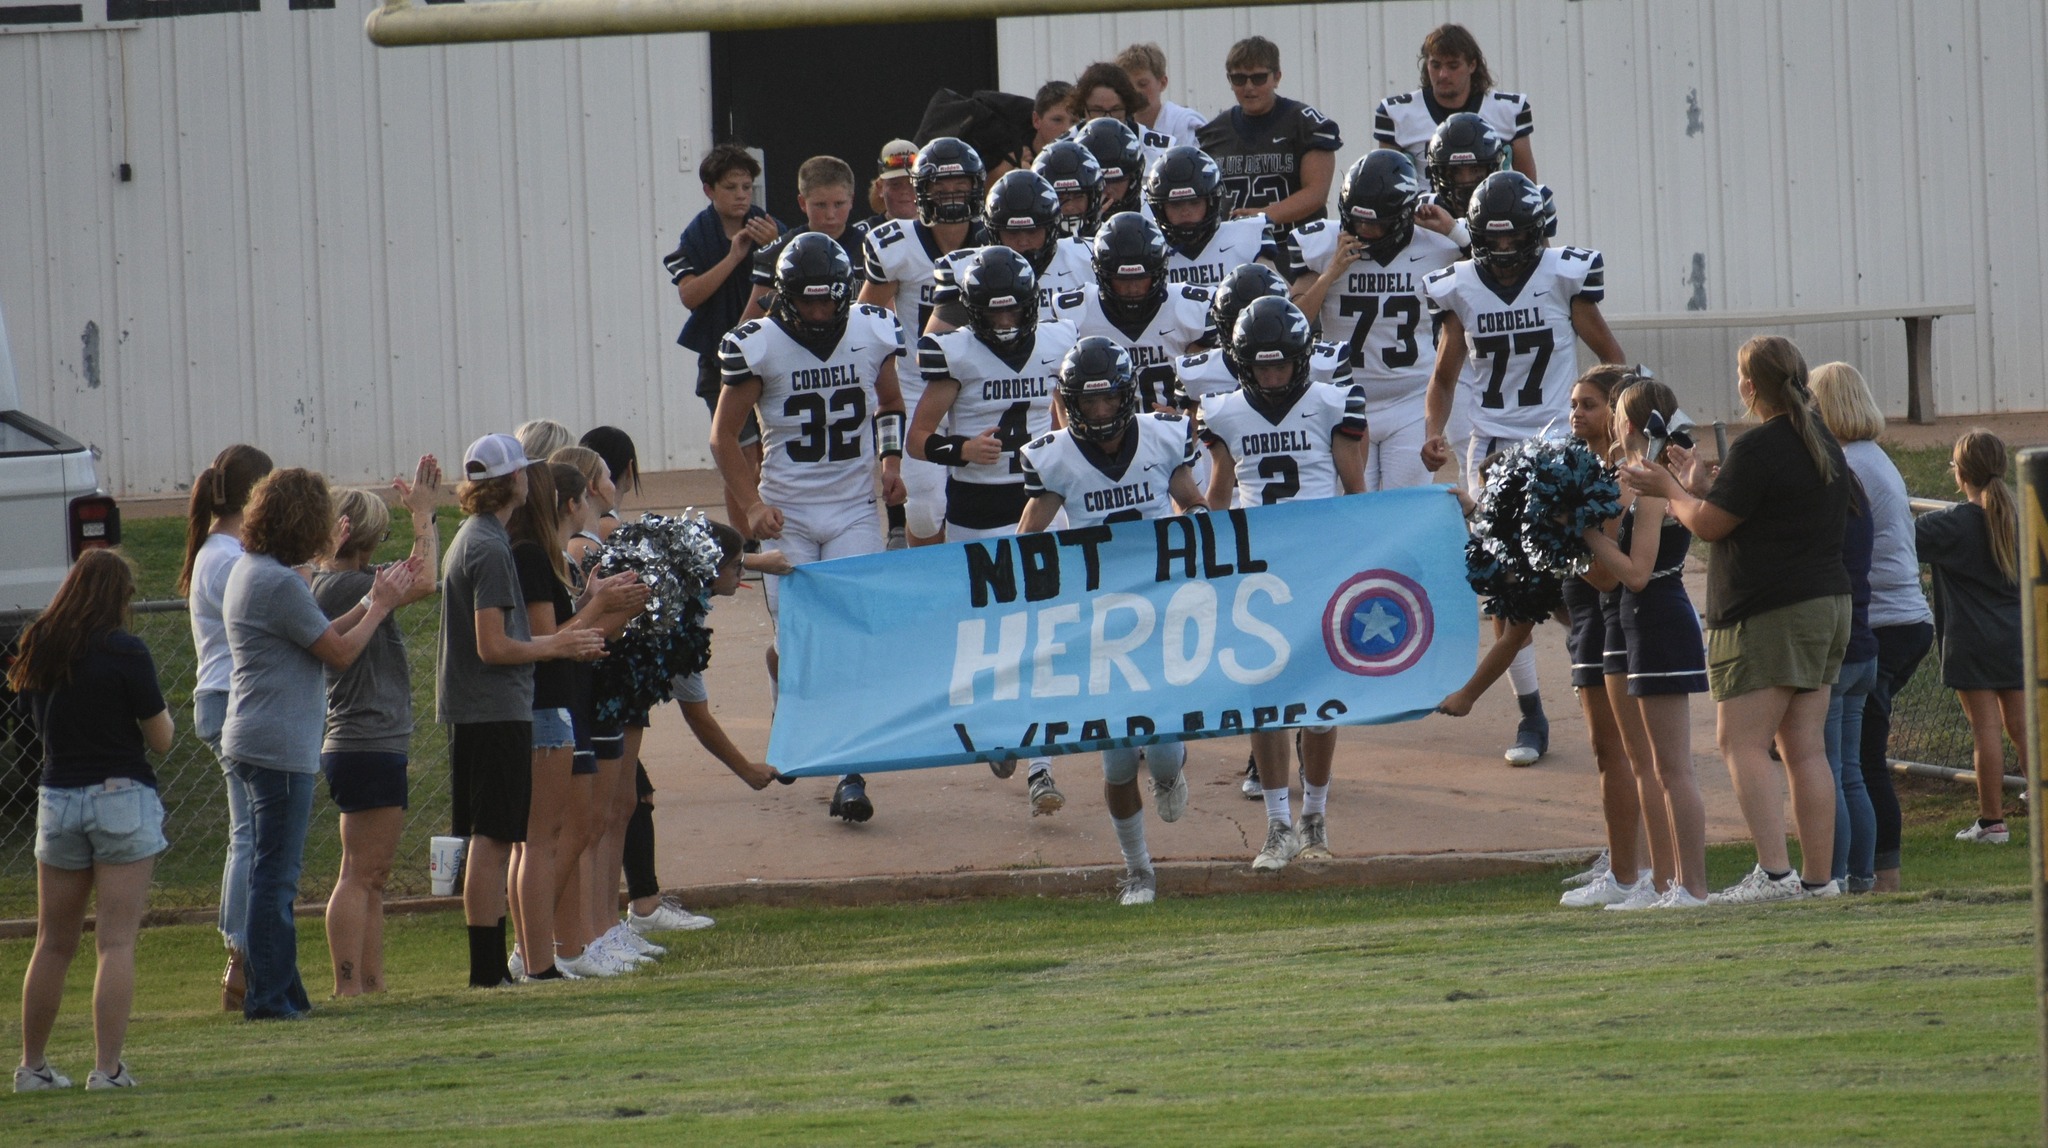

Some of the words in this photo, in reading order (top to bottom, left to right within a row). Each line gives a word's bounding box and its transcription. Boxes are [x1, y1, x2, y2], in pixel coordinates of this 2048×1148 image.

[1217, 155, 1244, 176] LUE
[1244, 153, 1294, 174] DEVILS
[873, 221, 905, 249] 51
[1169, 262, 1225, 284] ORDELL
[1348, 272, 1415, 293] CORDELL
[1340, 294, 1421, 369] 73
[1477, 306, 1545, 334] CORDELL
[791, 363, 860, 391] CORDELL
[1473, 328, 1555, 409] 77
[982, 376, 1048, 400] CORDELL
[783, 386, 866, 463] 32
[994, 401, 1032, 474] 4
[1241, 430, 1312, 456] CORDELL
[1257, 455, 1300, 505] 2
[1083, 481, 1154, 512] CORDELL
[963, 524, 1113, 608] NOT
[1154, 509, 1268, 582] ALL
[948, 573, 1293, 706] HEROS
